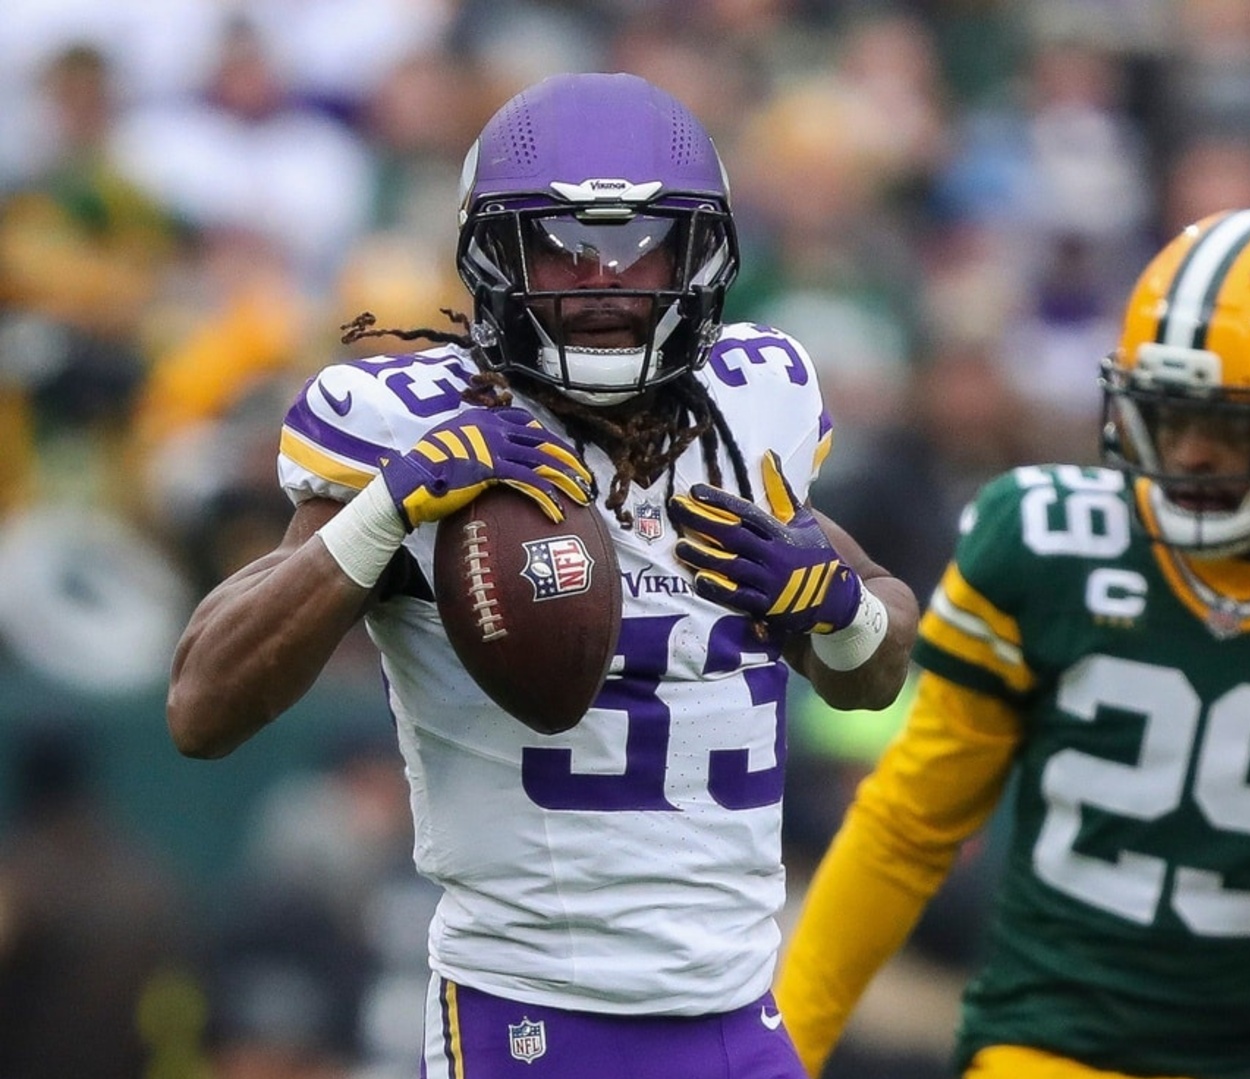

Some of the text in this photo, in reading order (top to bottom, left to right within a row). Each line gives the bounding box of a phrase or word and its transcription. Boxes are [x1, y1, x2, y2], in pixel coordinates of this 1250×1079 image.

[553, 541, 586, 590] NFL
[1085, 567, 1149, 618] C
[514, 1037, 540, 1055] NFL
